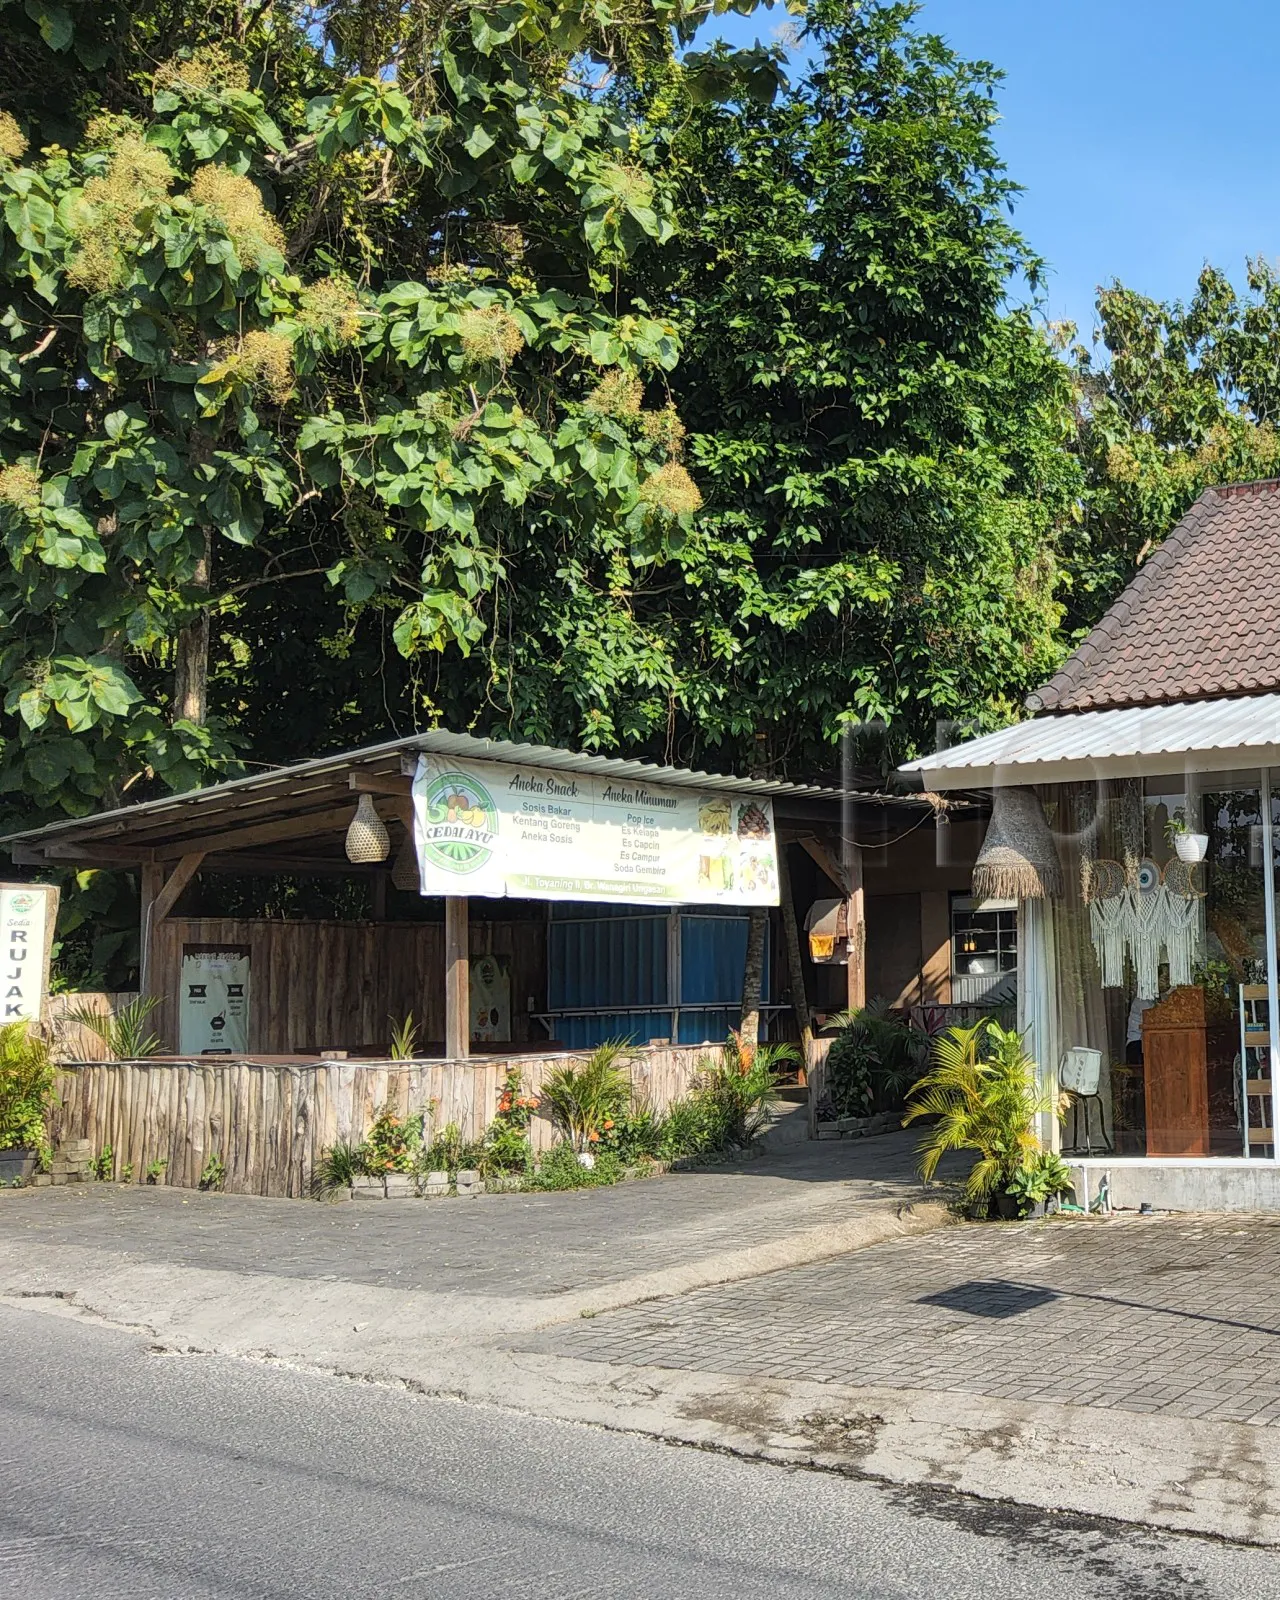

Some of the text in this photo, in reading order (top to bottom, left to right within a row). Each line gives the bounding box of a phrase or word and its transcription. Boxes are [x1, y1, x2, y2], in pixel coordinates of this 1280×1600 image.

[508, 774, 579, 798] Aneka Snack
[602, 786, 679, 809] Aneka Minuman
[522, 802, 572, 817] Sosis Bakar
[512, 815, 581, 833] Kentang Goreng
[627, 814, 655, 825] Pop Ice
[464, 829, 494, 844] AYU
[521, 830, 573, 844] Aneka Sosis
[621, 826, 660, 839] Es Kelapa
[622, 838, 660, 851] Es Capcin
[620, 851, 661, 863] Es Campur
[613, 863, 666, 876] Soda Gembira
[5, 930, 27, 1016] RUJAK
